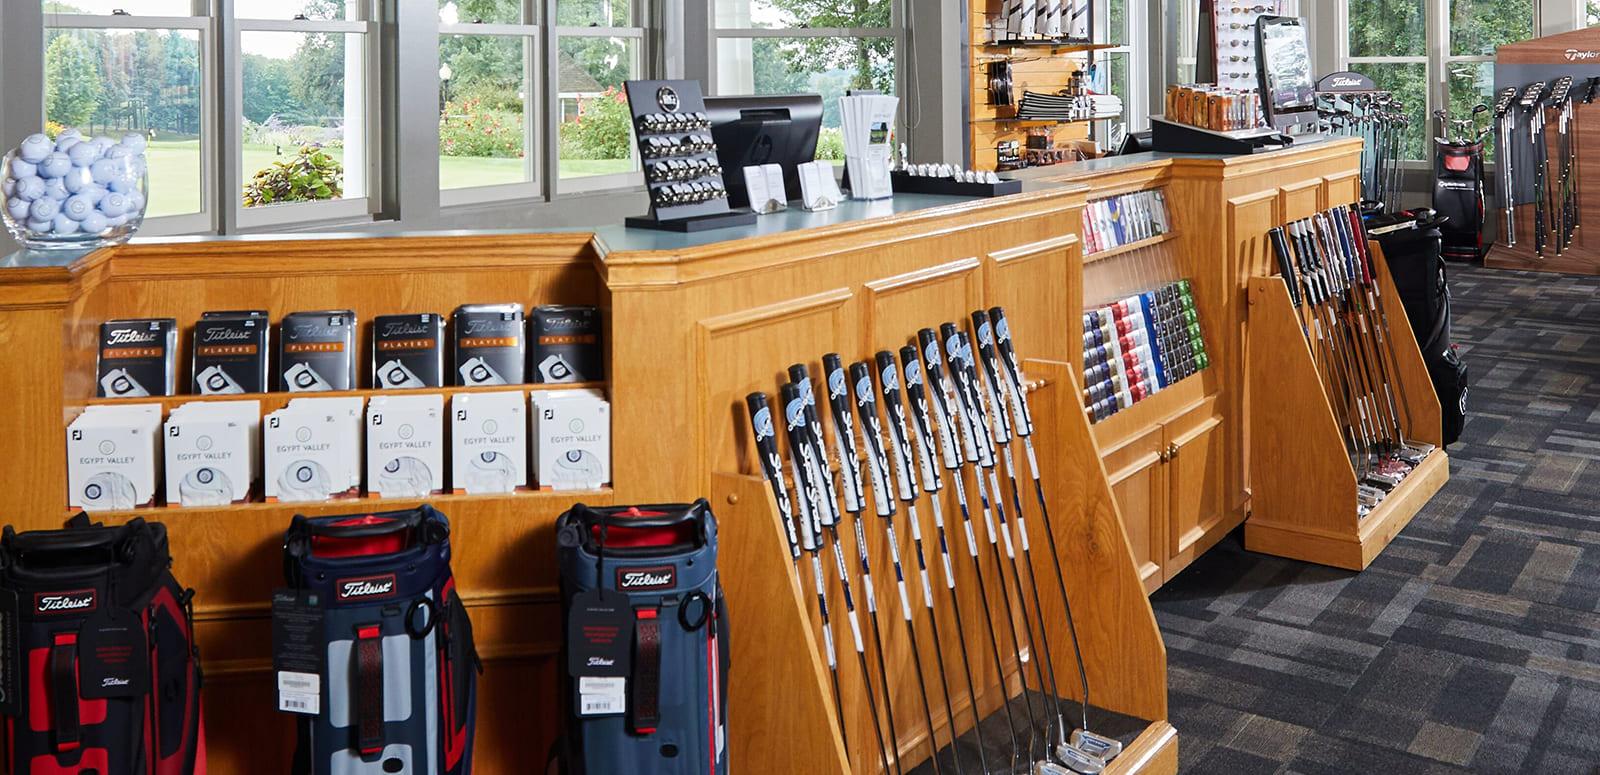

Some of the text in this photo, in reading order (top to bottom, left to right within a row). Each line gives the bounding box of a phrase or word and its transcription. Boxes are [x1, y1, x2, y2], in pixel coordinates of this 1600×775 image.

[1331, 77, 1362, 87] Titleist
[203, 327, 251, 342] Titleist
[383, 322, 428, 337] Titleist
[107, 329, 156, 345] Titleist
[108, 349, 155, 357] PLAYERS
[203, 346, 250, 354] PLAYERS
[379, 440, 432, 450] EGYPT VALLEY
[464, 436, 516, 445] EGYPT VALLEY
[551, 435, 601, 444] EGYPT VALLEY
[277, 443, 330, 453] EGYPT VALLEY
[842, 411, 862, 495] SuperStroke
[80, 456, 135, 465] EGYPT VALLEY
[177, 452, 232, 461] EGYPT VALLEY
[870, 417, 892, 499] SuperStroke
[812, 421, 837, 508] SuperStroke
[799, 443, 821, 531] SuperStroke
[769, 453, 797, 543] SuperStroke
[621, 572, 672, 588] Titleist
[341, 580, 393, 597] Titleist
[38, 596, 93, 612] Titleist
[586, 656, 615, 667] Titleist
[101, 677, 130, 687] Titleist
